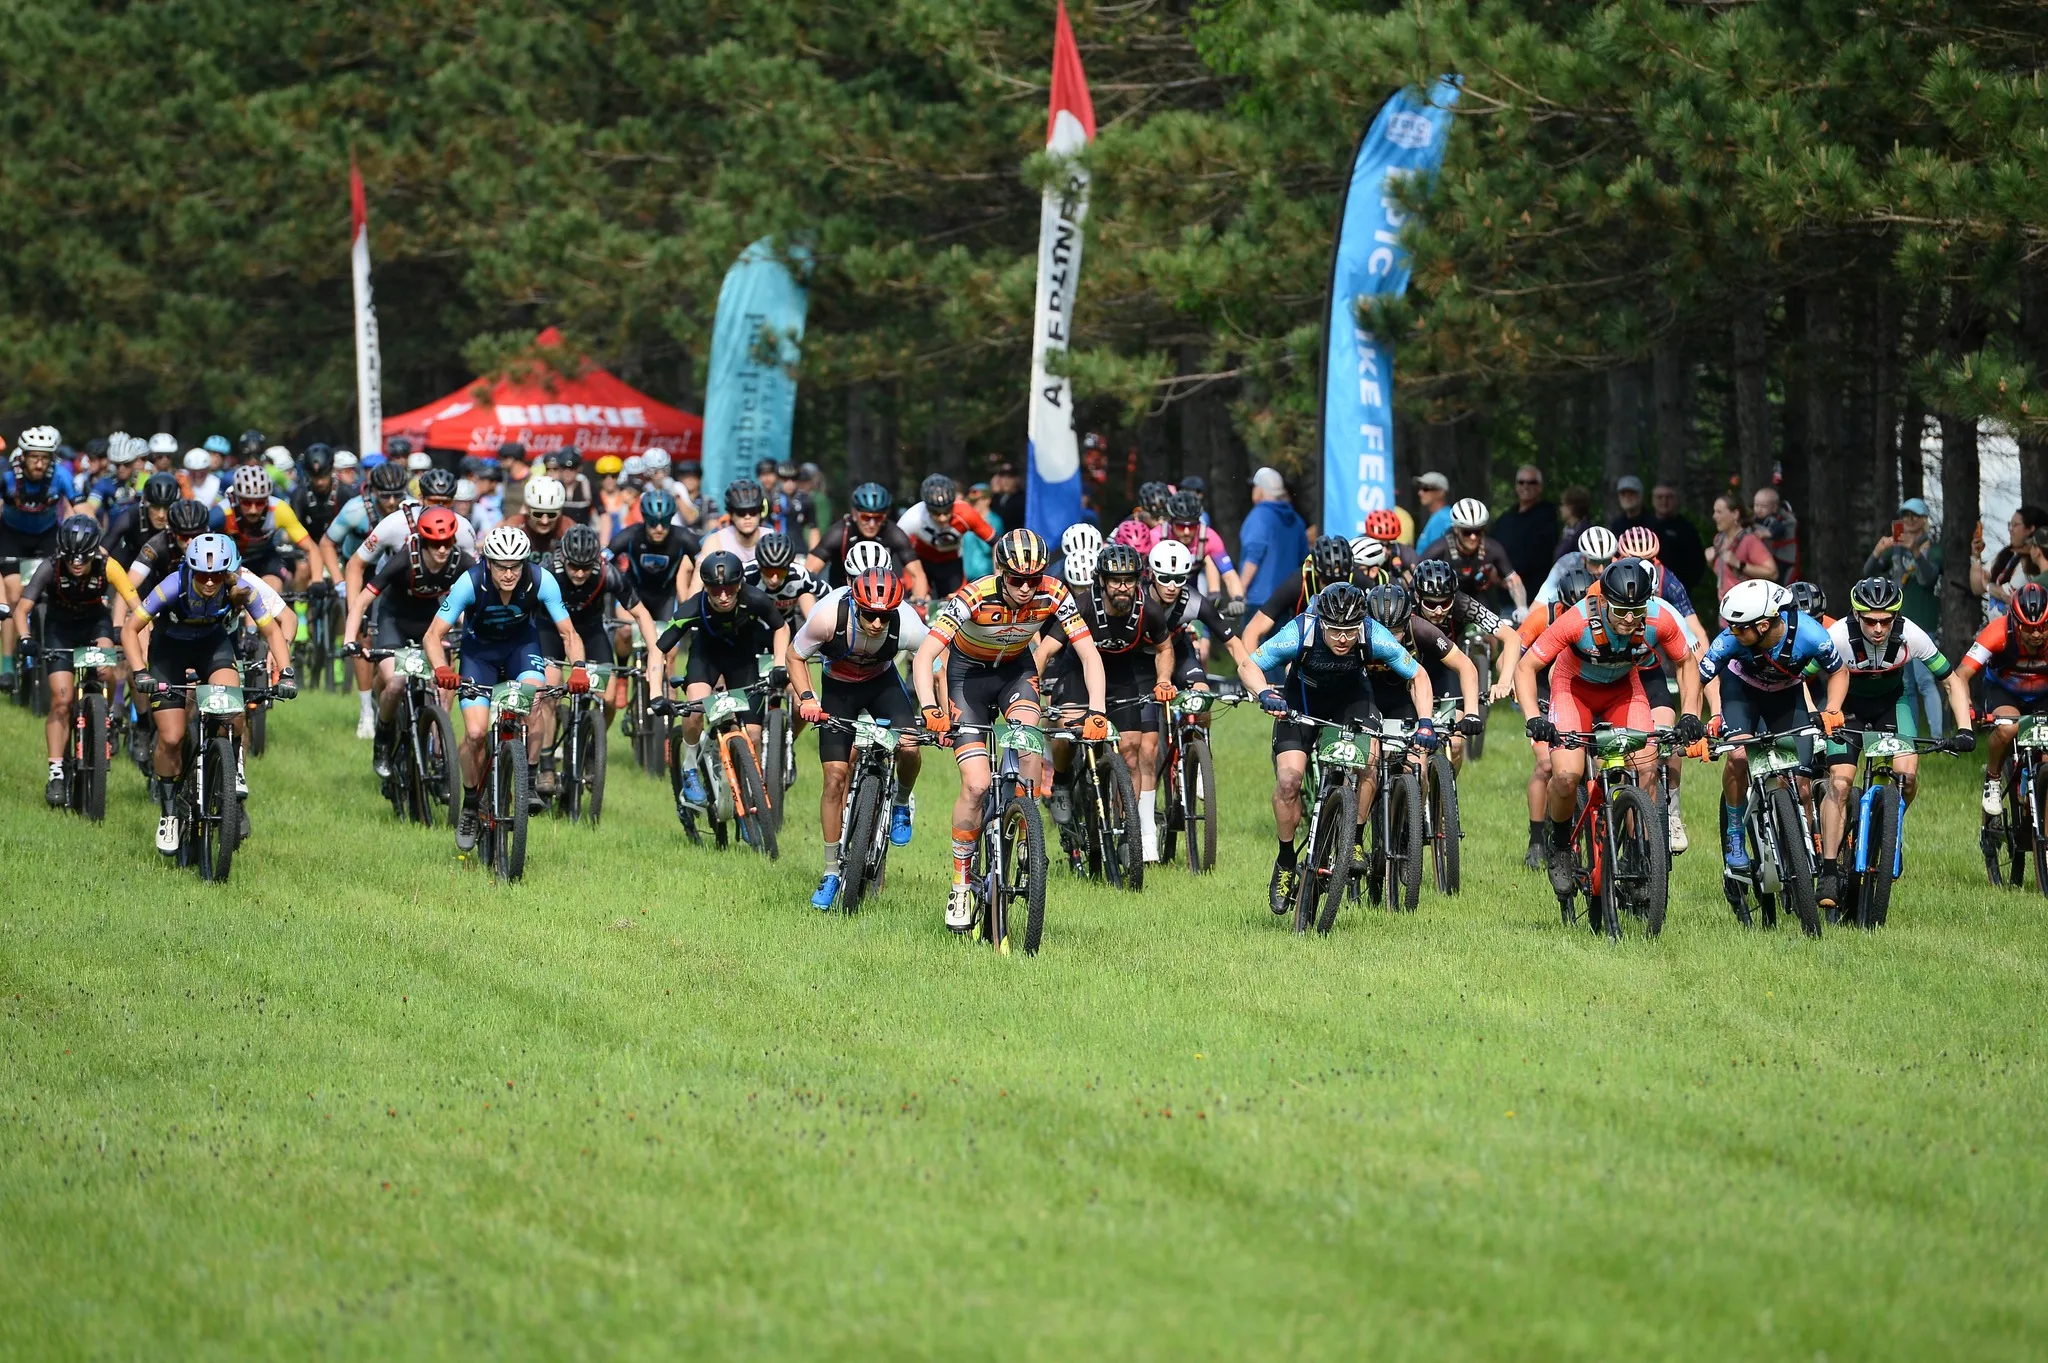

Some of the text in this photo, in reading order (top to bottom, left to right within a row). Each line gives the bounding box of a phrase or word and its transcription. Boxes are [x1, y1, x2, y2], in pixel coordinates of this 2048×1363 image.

[495, 403, 648, 428] BIRKIE
[209, 693, 229, 710] 51
[2031, 725, 2048, 741] 15
[1333, 741, 1357, 761] 29
[1877, 738, 1901, 752] 43
